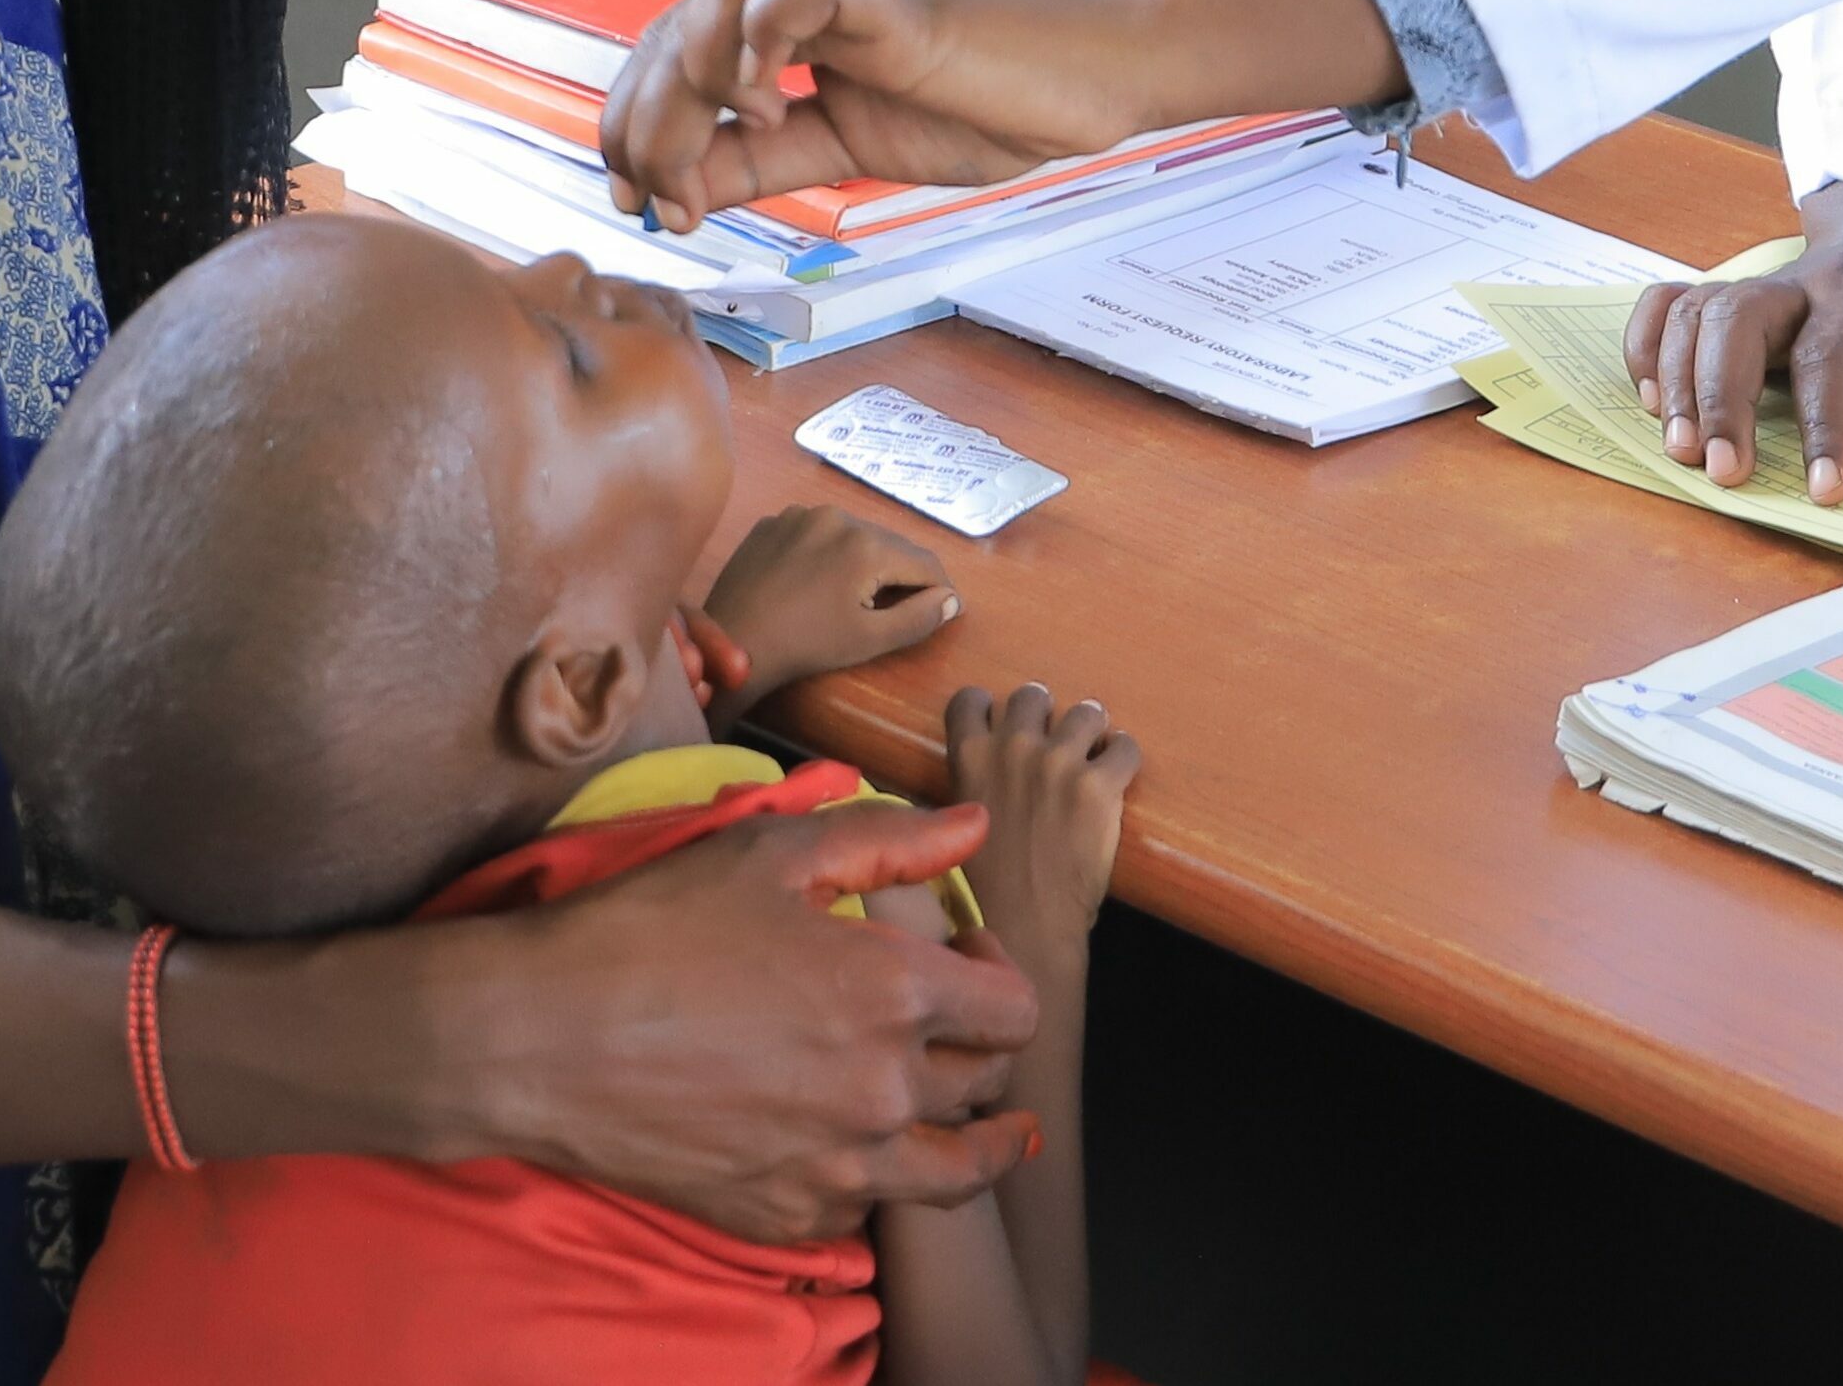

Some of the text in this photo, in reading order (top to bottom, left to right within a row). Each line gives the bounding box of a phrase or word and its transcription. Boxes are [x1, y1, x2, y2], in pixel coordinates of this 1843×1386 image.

[1264, 258, 1325, 282] Chemistry
[1166, 279, 1228, 302] Requested
[1078, 292, 1312, 381] LABORATORY REQUEST FORM
[1328, 339, 1393, 362] Requested
[1209, 360, 1314, 397] HEALTH CENTER
